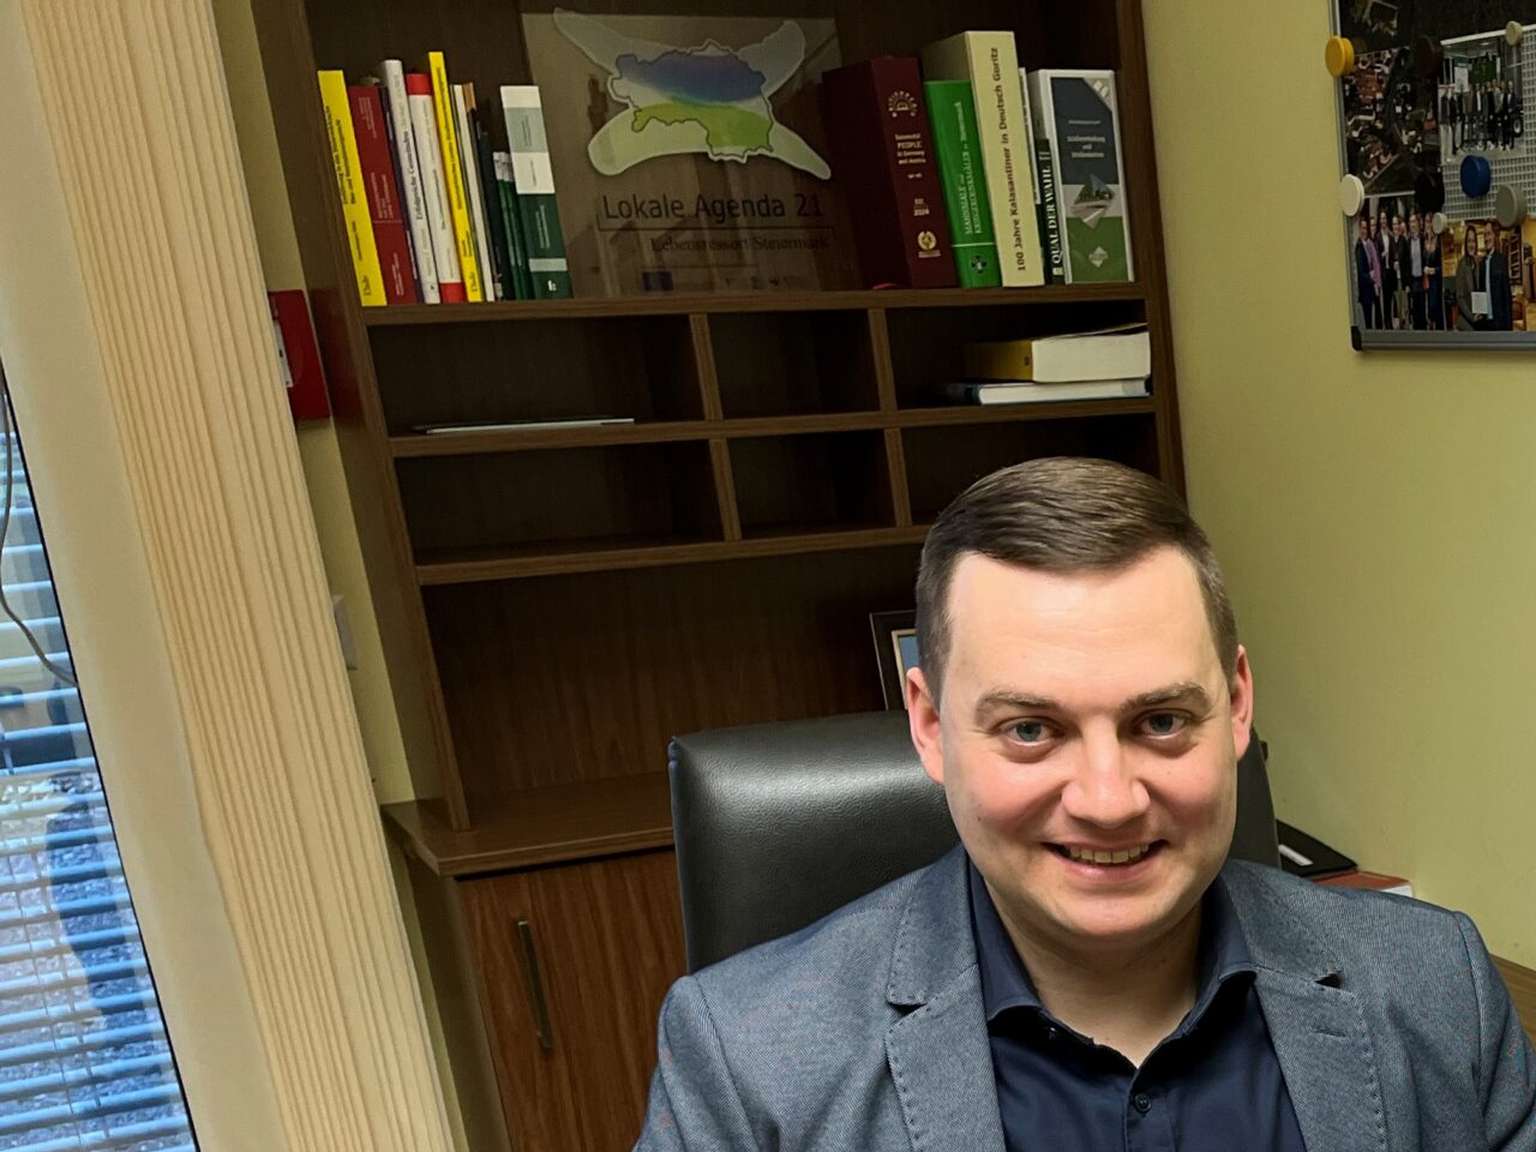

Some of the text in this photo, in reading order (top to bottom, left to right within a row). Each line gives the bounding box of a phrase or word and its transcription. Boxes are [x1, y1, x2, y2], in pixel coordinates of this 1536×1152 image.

[991, 47, 1026, 271] 100 Jahre Kalasantiner in Deutsch Goritz
[1042, 165, 1056, 203] WAHL
[602, 193, 825, 224] Lokale Agenda 21
[1046, 203, 1058, 231] DER
[1050, 232, 1063, 264] QUAL
